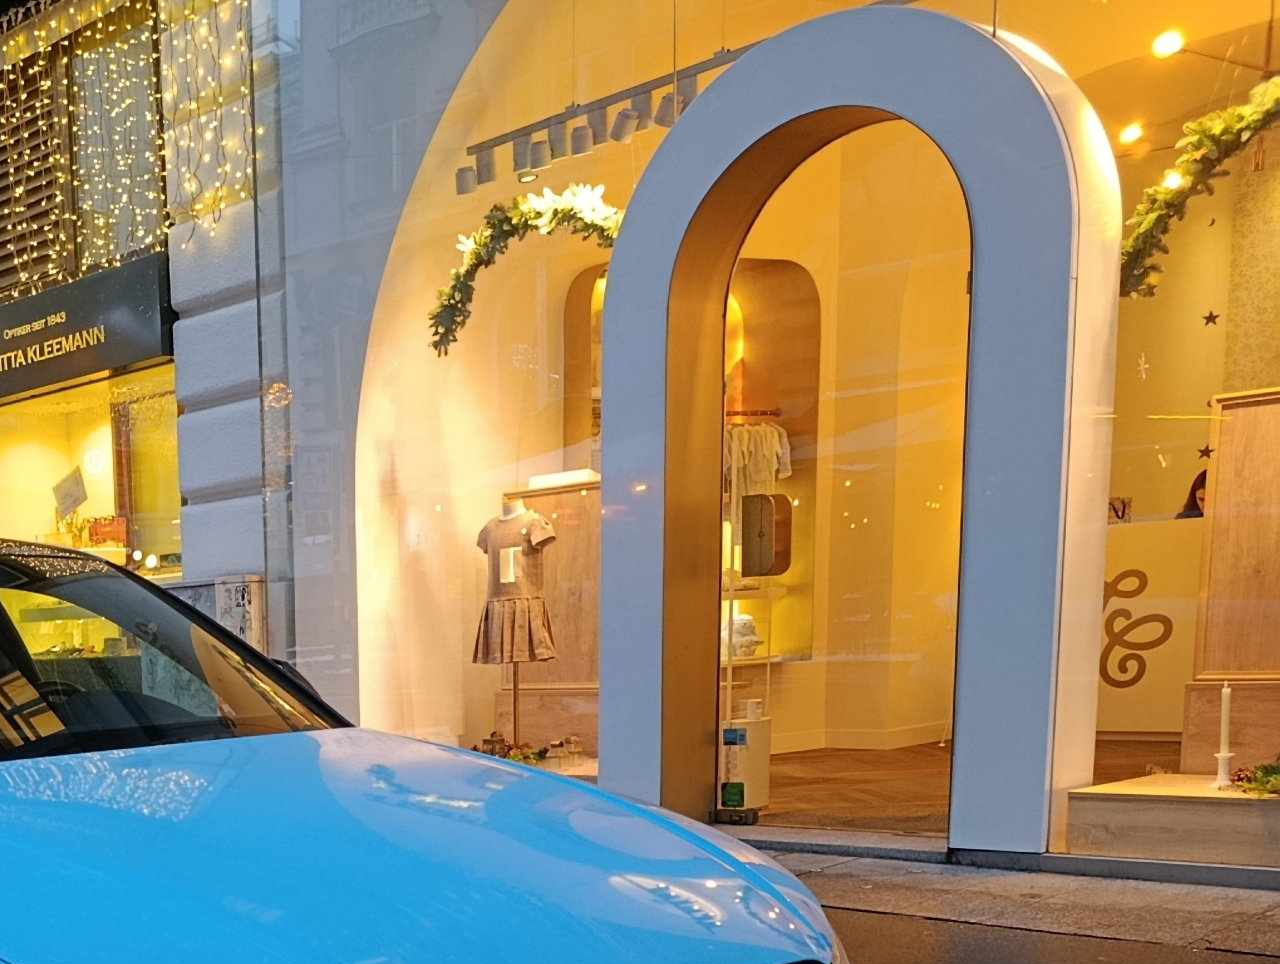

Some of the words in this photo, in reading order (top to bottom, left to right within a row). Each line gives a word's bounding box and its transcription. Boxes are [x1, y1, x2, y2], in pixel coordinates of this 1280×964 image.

[31, 319, 46, 332] SEIT
[47, 311, 67, 328] 1843
[27, 324, 106, 364] KLEEMANN
